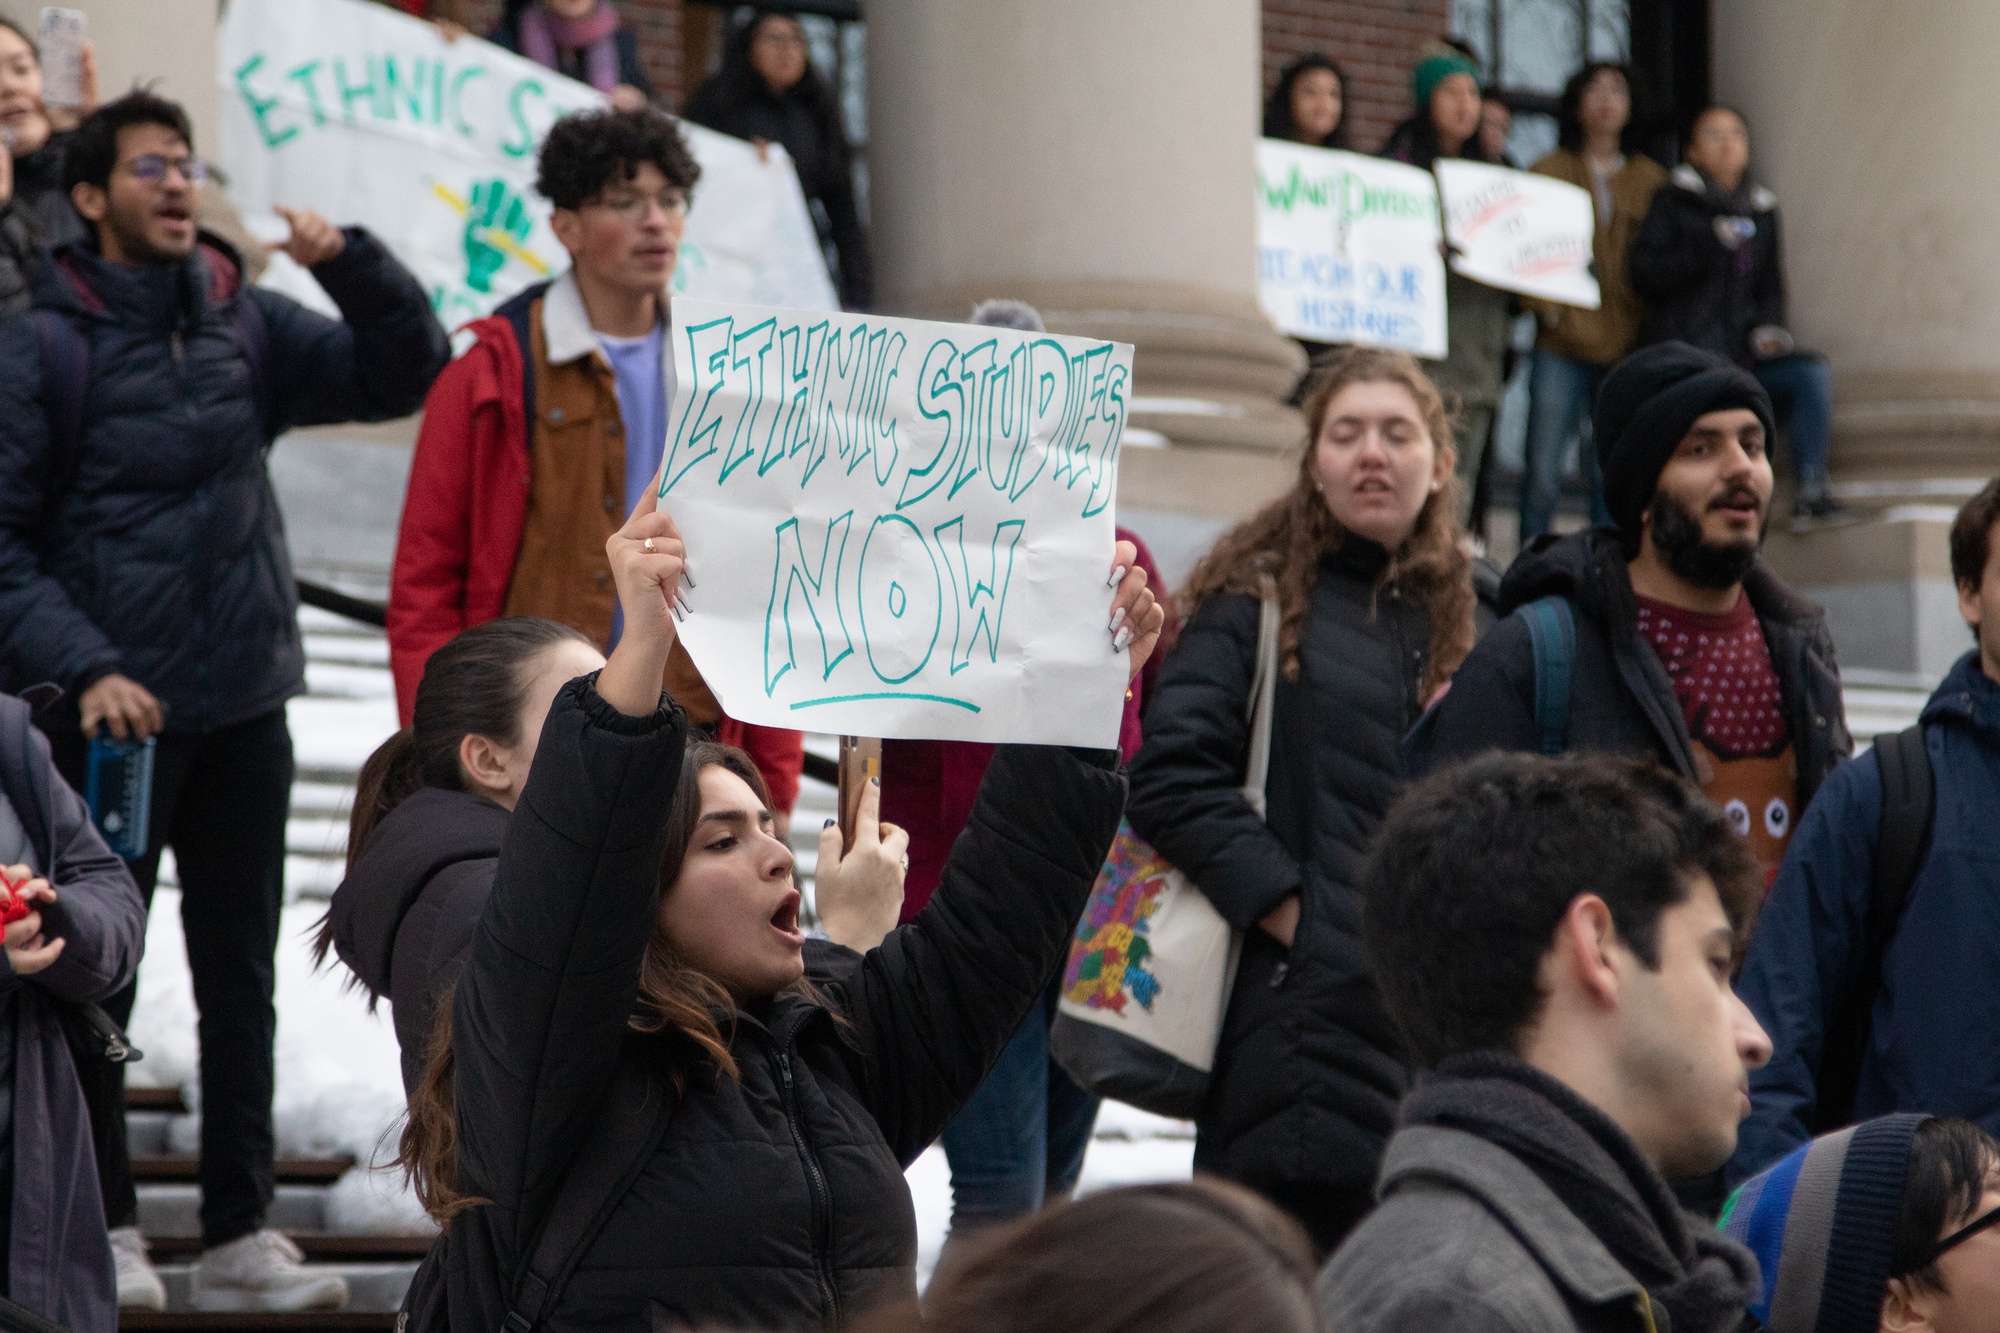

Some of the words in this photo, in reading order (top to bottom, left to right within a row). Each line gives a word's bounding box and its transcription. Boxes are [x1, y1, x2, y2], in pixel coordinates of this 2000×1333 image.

[236, 52, 486, 150] ETHNIC
[1338, 172, 1437, 221] DIVERSI
[1363, 261, 1424, 302] OUR
[658, 317, 907, 498] ETHNIC
[896, 338, 1128, 518] STUDIES
[763, 510, 1025, 697] NOW
